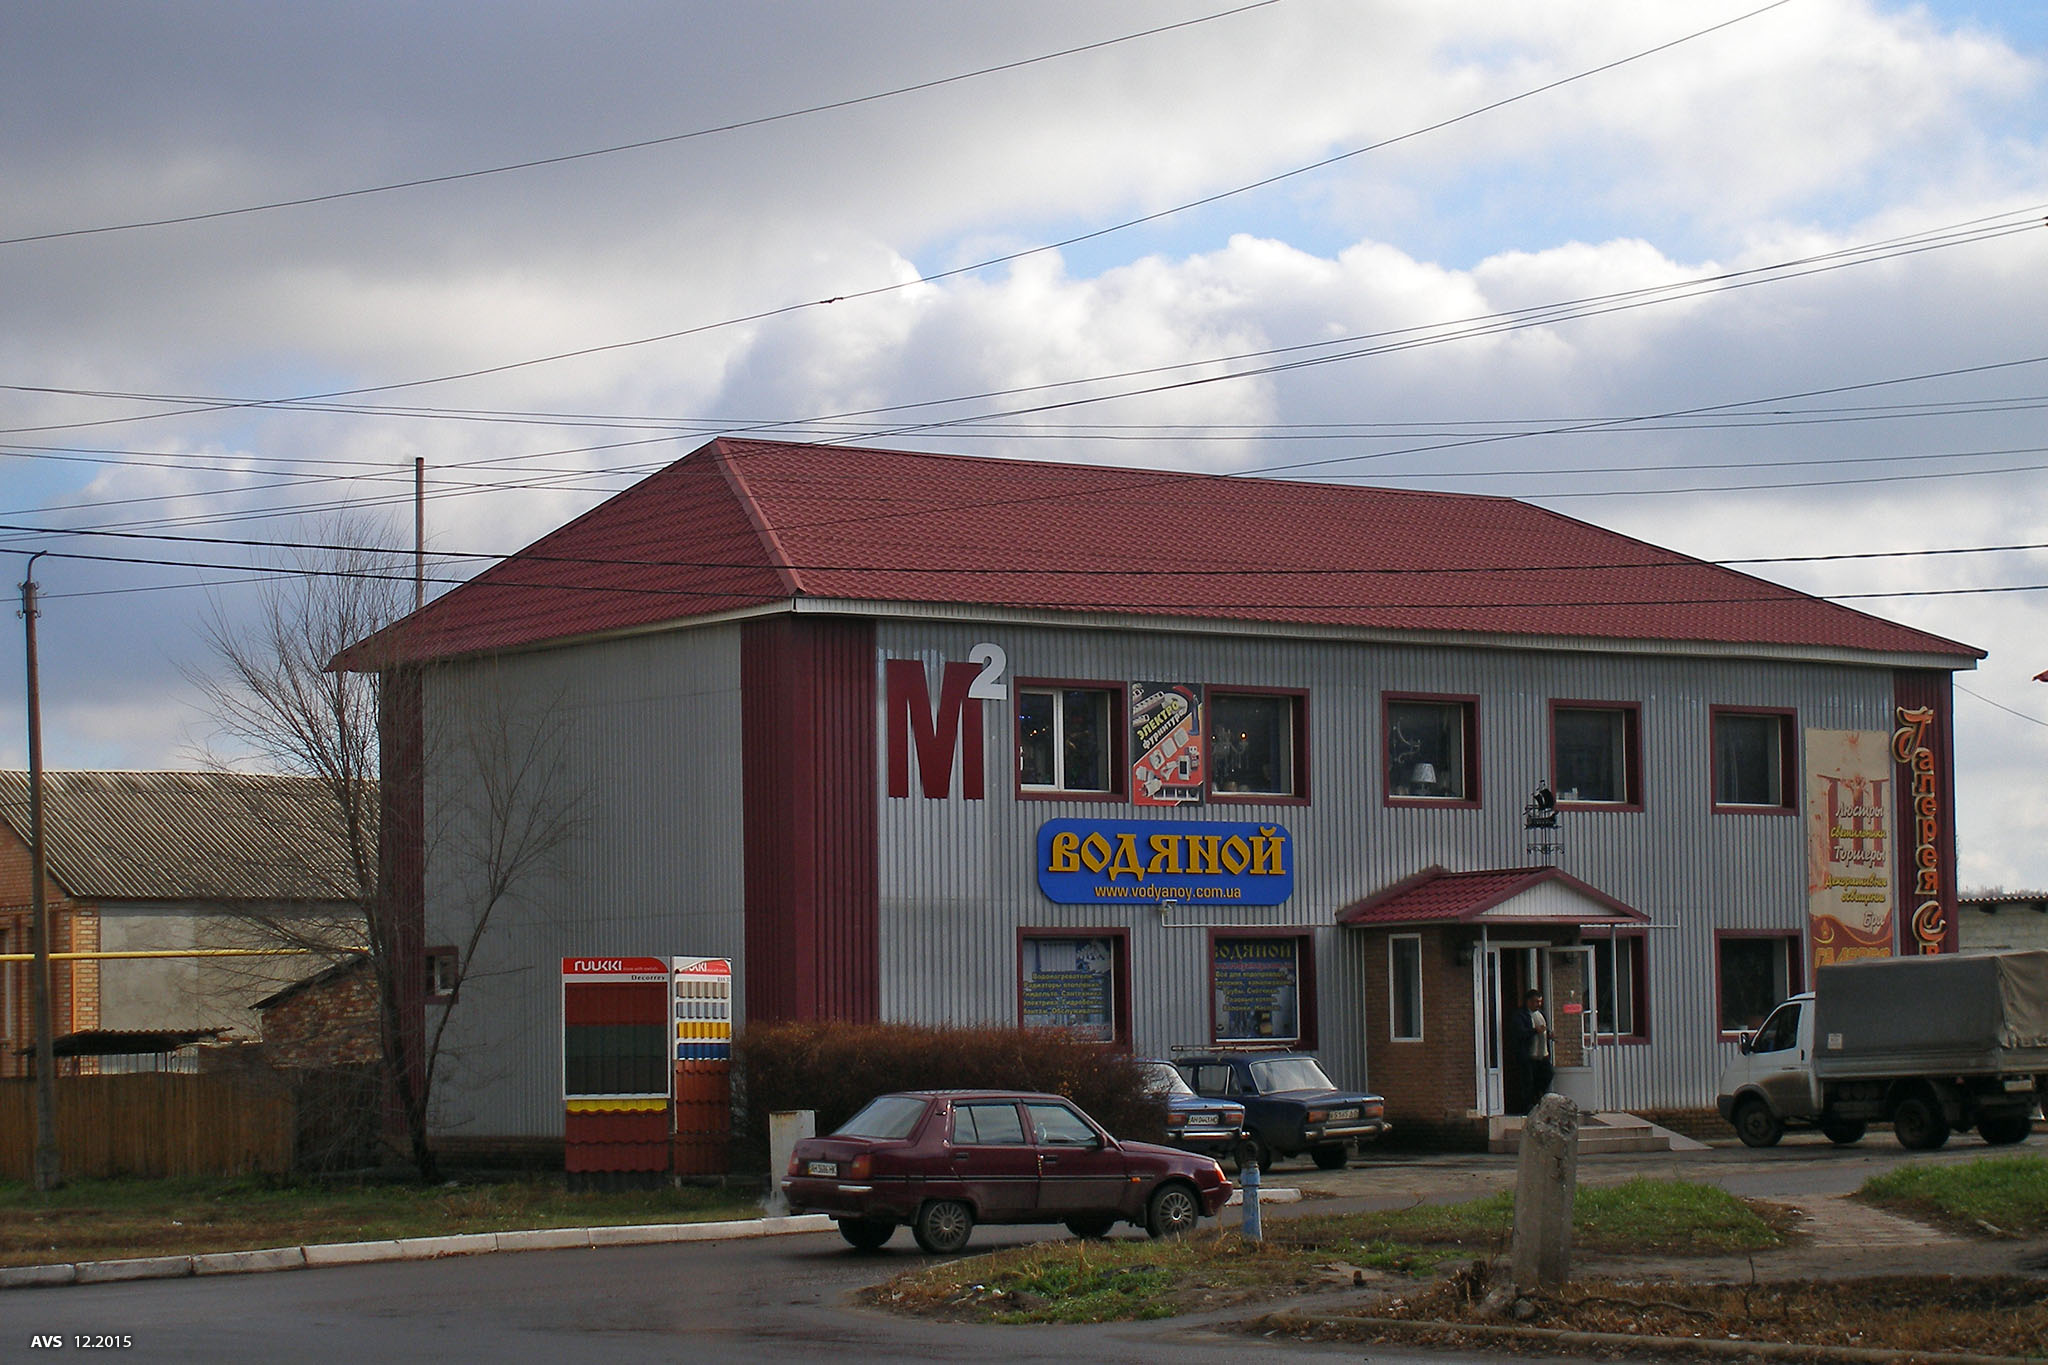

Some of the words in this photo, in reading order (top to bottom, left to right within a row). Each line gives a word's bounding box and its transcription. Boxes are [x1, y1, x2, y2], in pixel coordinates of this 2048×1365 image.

[1137, 701, 1180, 740] ЭЛЕКТРО
[1835, 802, 1884, 824] Люстры
[1834, 846, 1885, 868] Торшеры
[1094, 885, 1241, 901] www.vodyanoy.com.ua
